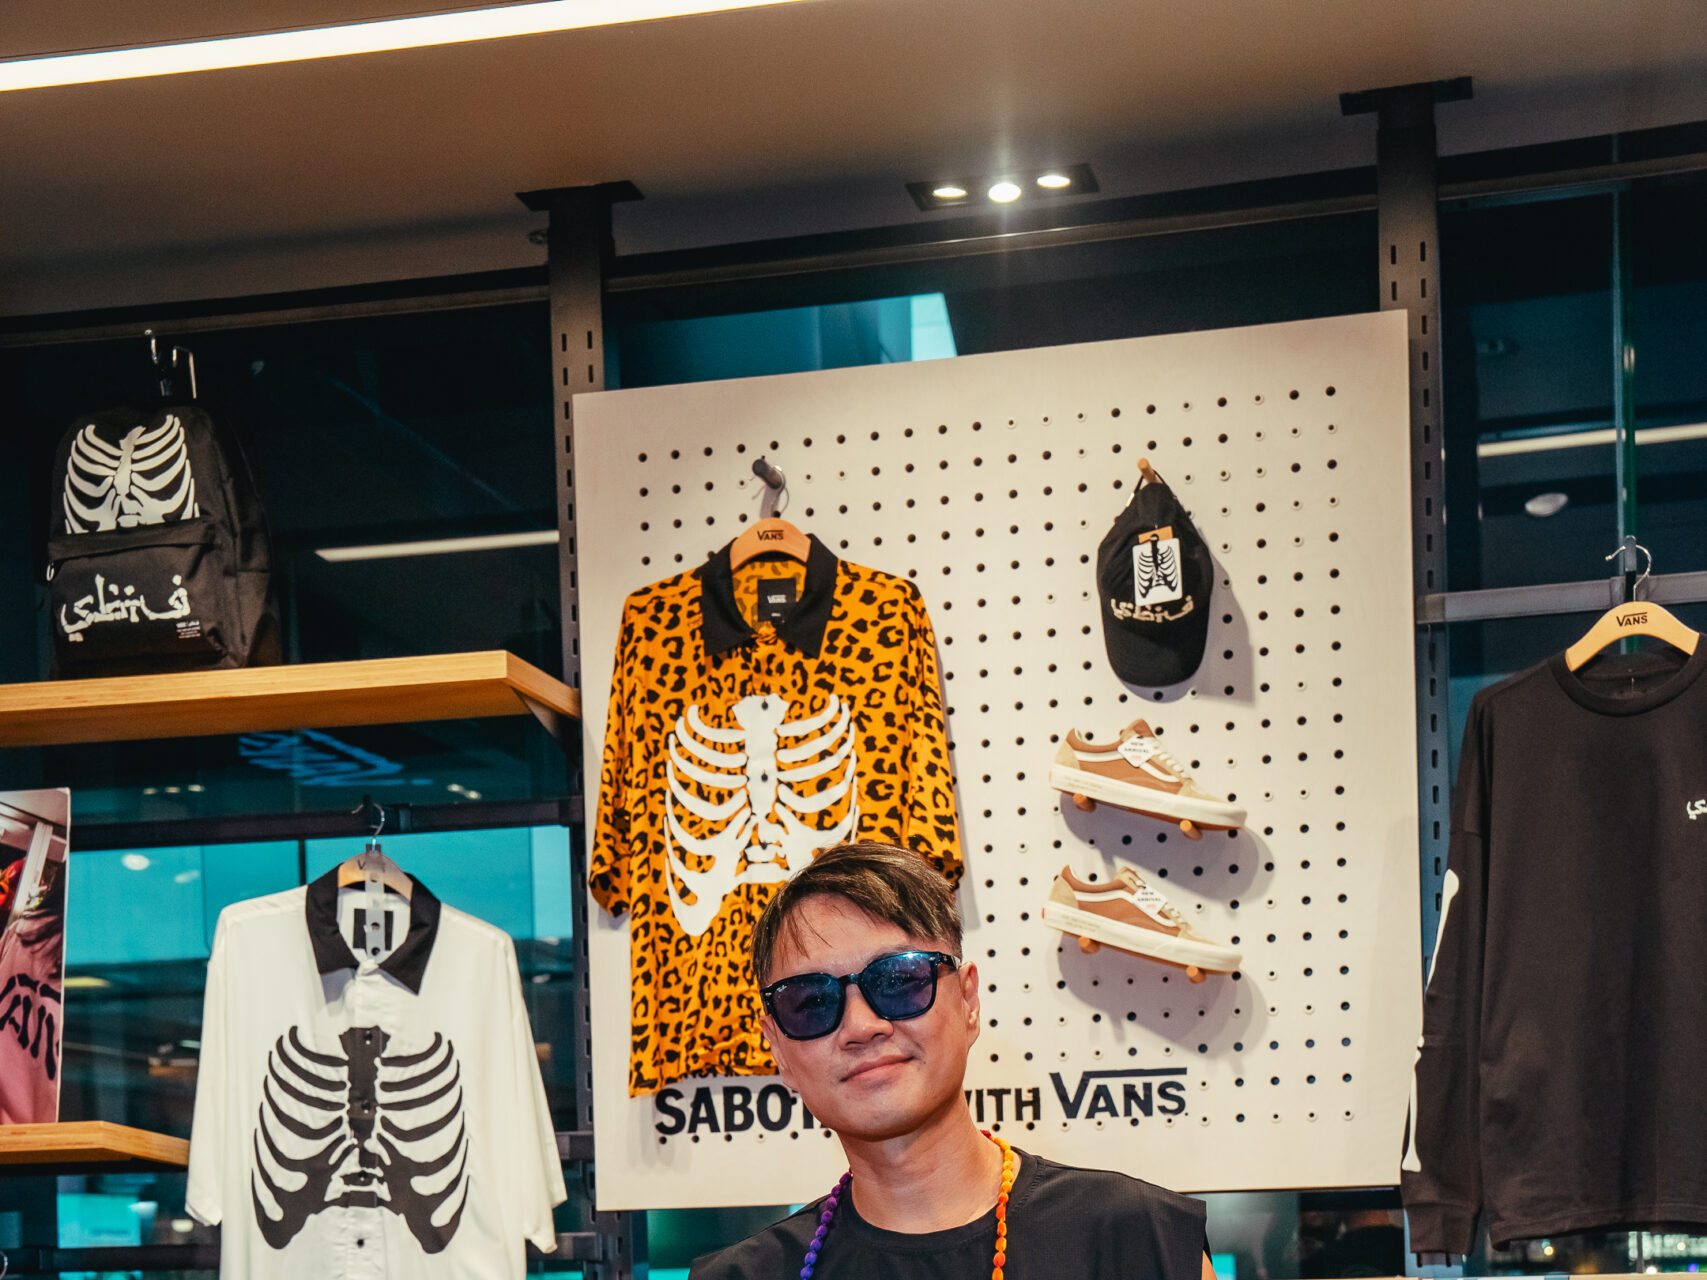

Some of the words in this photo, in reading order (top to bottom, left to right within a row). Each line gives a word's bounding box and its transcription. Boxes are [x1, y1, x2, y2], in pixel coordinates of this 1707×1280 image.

[757, 530, 784, 541] VANS
[767, 594, 787, 604] VANS
[1616, 611, 1648, 627] VANS
[655, 1084, 833, 1135] SABOT
[1049, 1067, 1187, 1119] VANS
